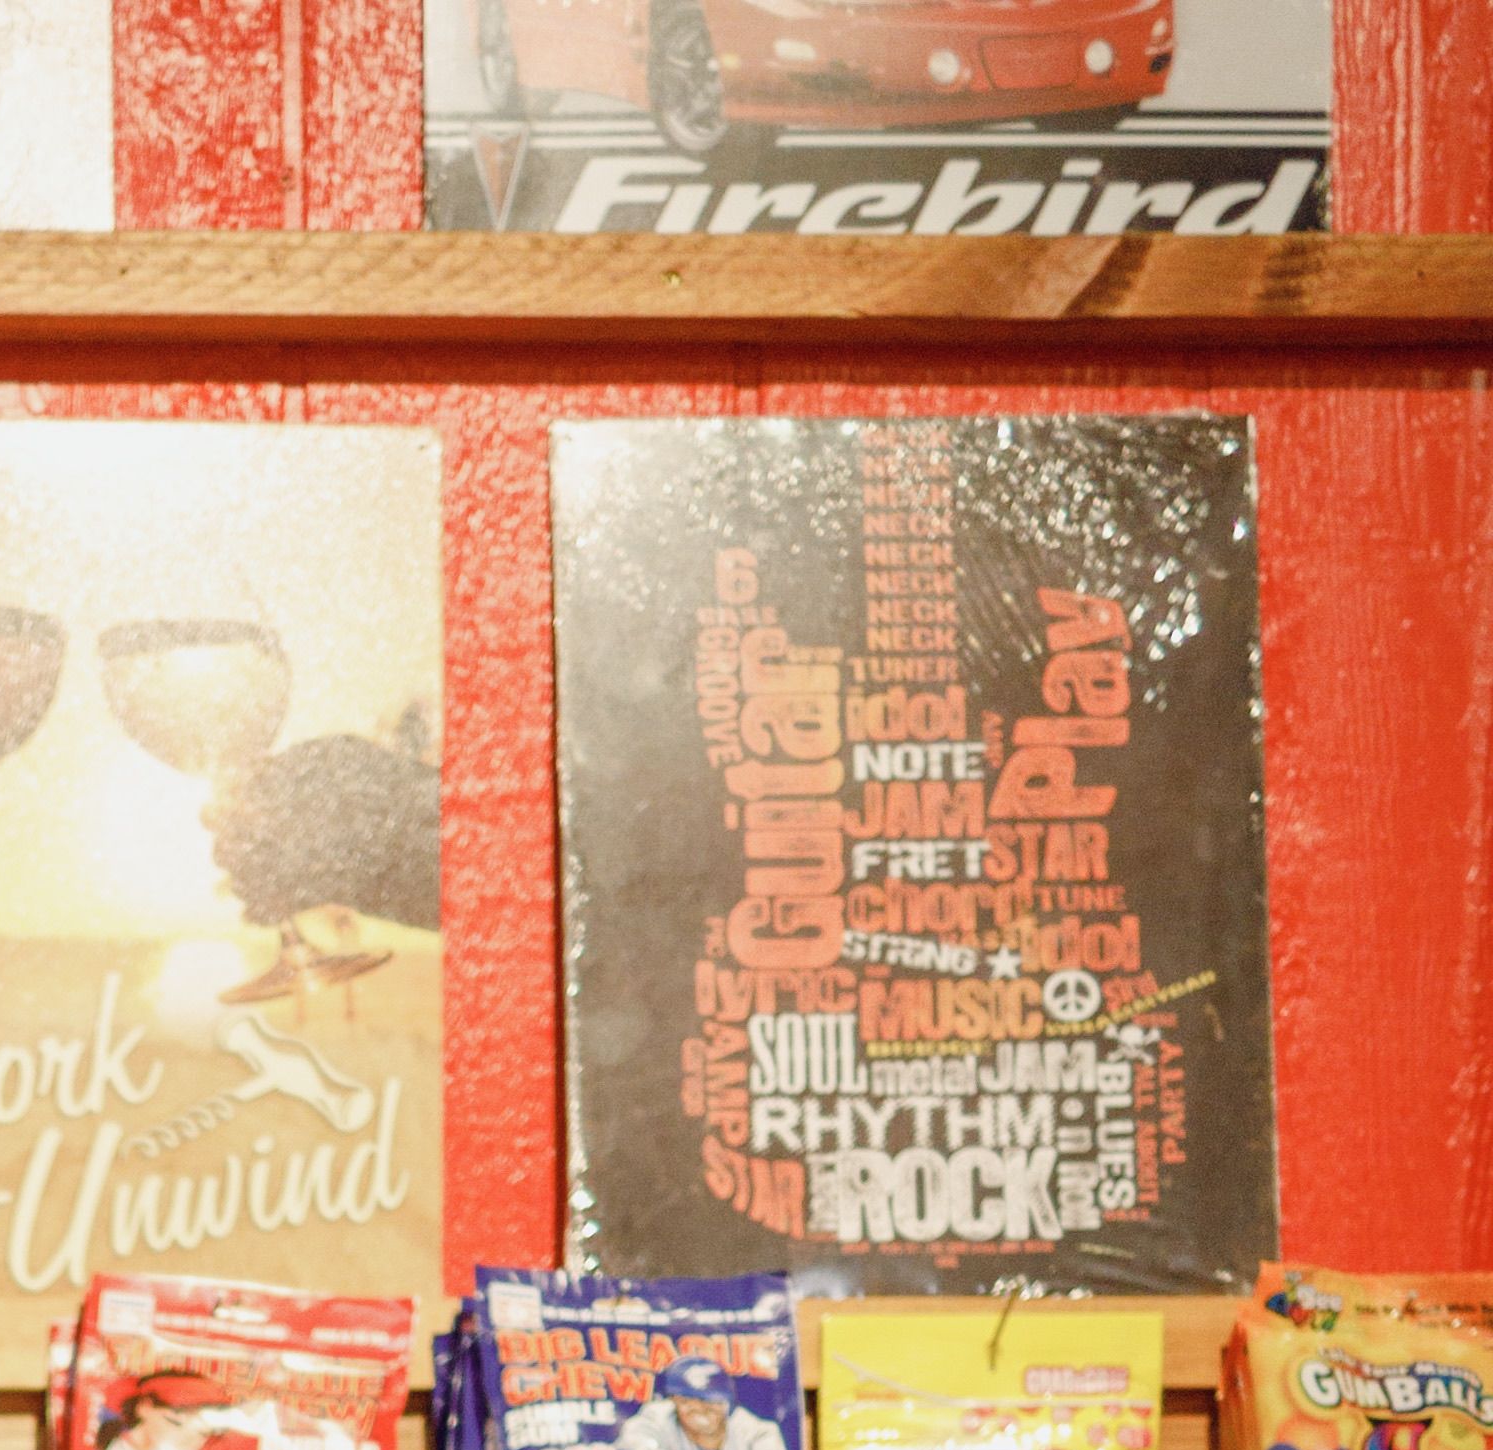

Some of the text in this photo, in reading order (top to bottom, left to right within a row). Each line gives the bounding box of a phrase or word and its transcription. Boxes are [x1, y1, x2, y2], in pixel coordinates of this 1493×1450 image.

[552, 156, 1319, 235] Firebird
[862, 512, 954, 536] NECK
[864, 542, 955, 566] NECK
[865, 571, 956, 594] NECK
[867, 599, 958, 624] NECK
[867, 627, 958, 651] NECK
[848, 655, 959, 682] TUNER
[988, 586, 1132, 818] Play
[852, 741, 987, 781] NOTE
[843, 780, 985, 839] JAM
[851, 840, 990, 880] FRET
[982, 822, 1109, 881] STAR
[1033, 885, 1127, 912] TUNE
[843, 929, 978, 976] STRING
[859, 978, 1044, 1041] MUSIC
[748, 1012, 869, 1096] SOUL
[871, 1054, 978, 1097] metal
[979, 1040, 1098, 1094] JAM
[750, 1095, 1057, 1151] RHYTHM
[1096, 1061, 1136, 1210] BLUES
[6, 1075, 409, 1293] Unwind
[838, 1147, 1063, 1242] ROCK
[495, 1326, 781, 1382] BIG LEAGUE
[501, 1364, 657, 1406] CHEW
